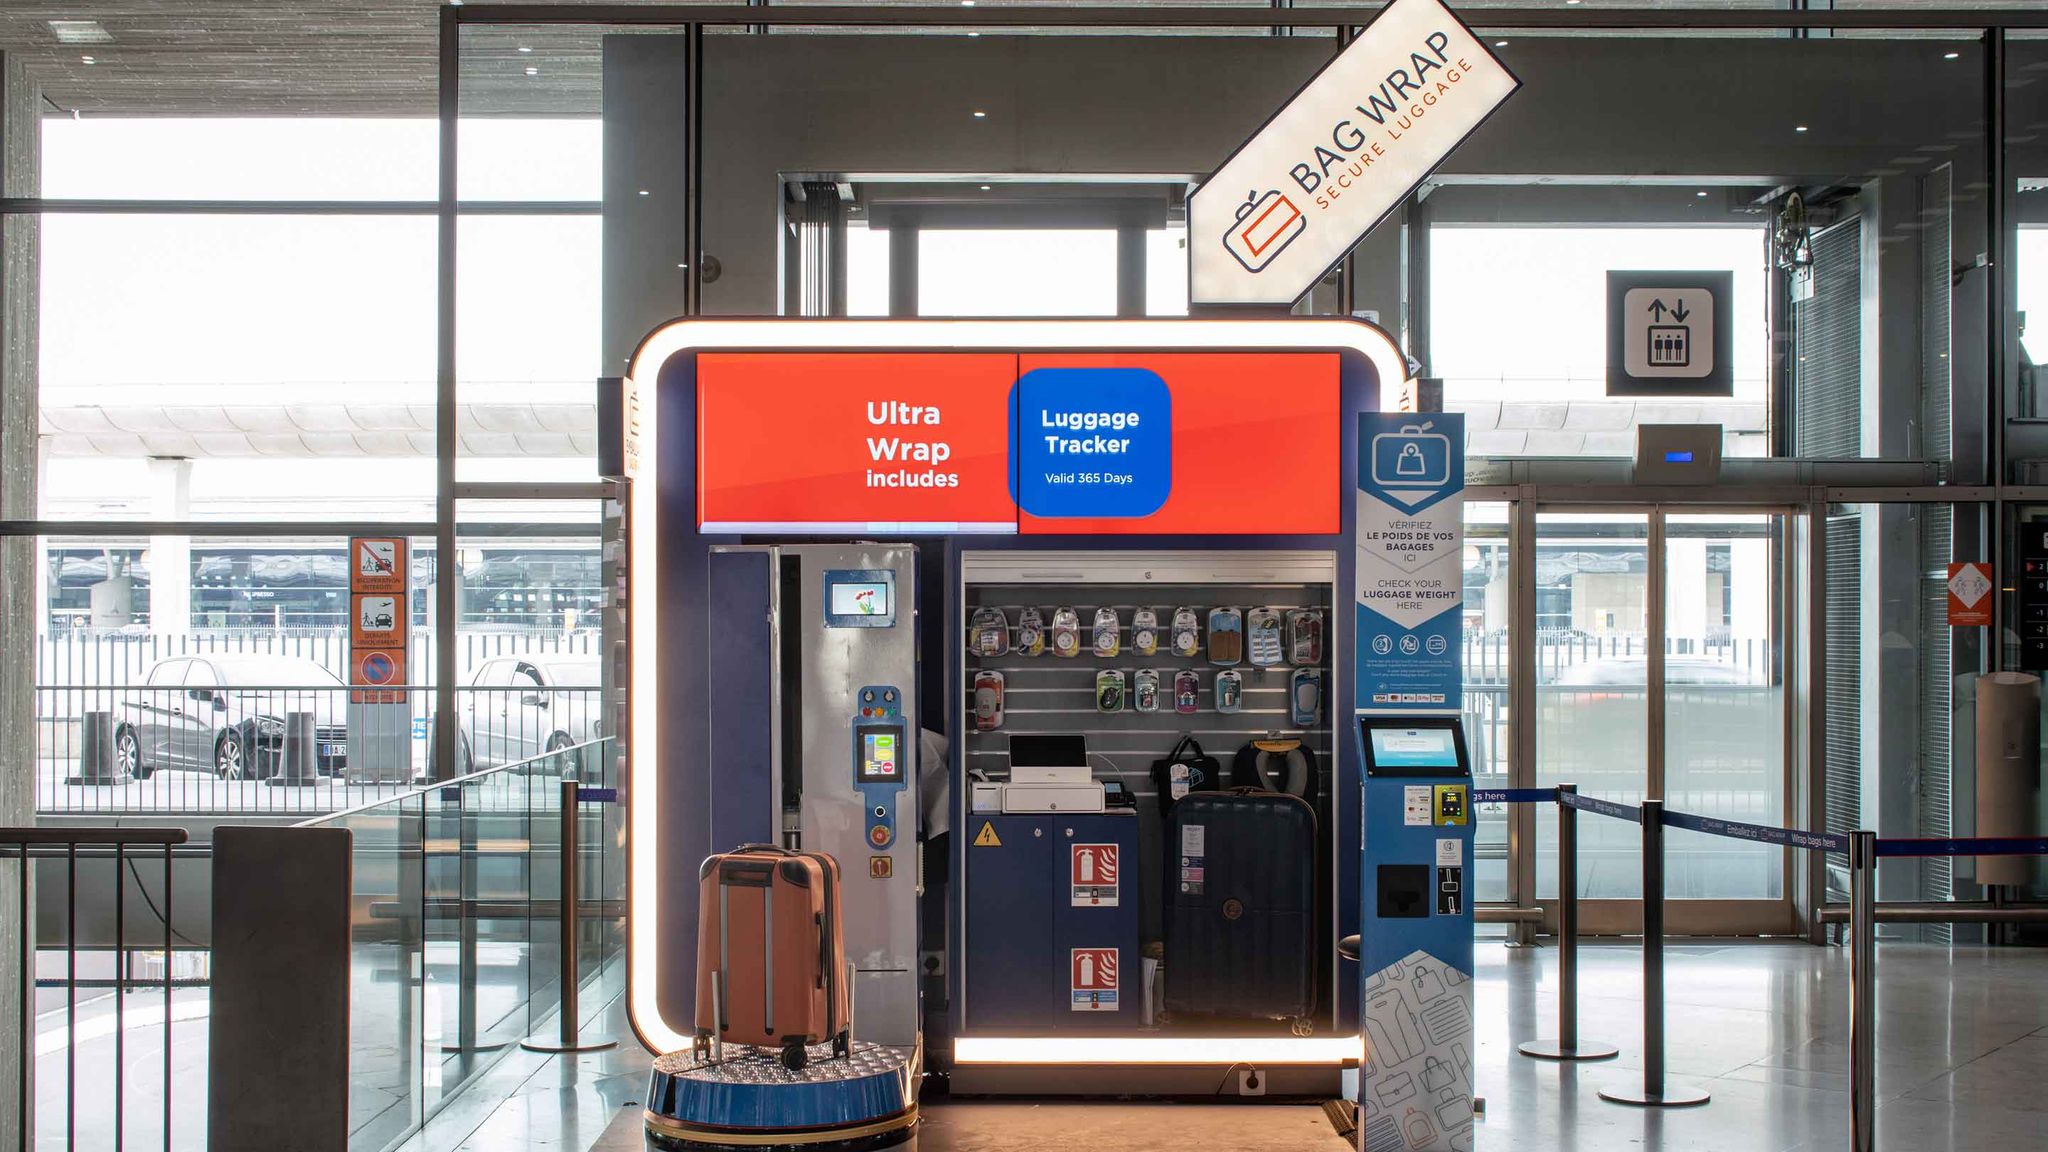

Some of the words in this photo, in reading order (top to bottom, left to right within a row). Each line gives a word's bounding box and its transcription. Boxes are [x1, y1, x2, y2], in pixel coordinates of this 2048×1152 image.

[1288, 120, 1366, 195] BAG
[1355, 30, 1450, 125] WRAP
[1315, 142, 1386, 210] SECURE
[1388, 58, 1472, 140] LUGGAGE
[867, 400, 941, 425] Ultra
[1042, 409, 1140, 431] Luggage
[867, 437, 951, 465] Wrap
[1045, 435, 1130, 454] Tracker
[866, 470, 959, 489] includes
[1045, 472, 1075, 484] Valid
[1078, 472, 1101, 484] 365
[1104, 472, 1134, 485] Days
[1388, 520, 1433, 530] VÉRIFIEZ
[1366, 531, 1379, 540] LE
[1382, 531, 1413, 540] POIDS
[1416, 532, 1430, 540] DE
[1433, 532, 1454, 541] VOS
[1386, 543, 1435, 552] BAGAGES
[1403, 554, 1417, 562] ICI
[1378, 579, 1411, 588] CHECK
[1414, 579, 1442, 588] YOUR
[1363, 591, 1412, 599] LUGGAGE
[1415, 591, 1457, 599] WEIGHT
[1396, 602, 1423, 610] HERE
[1485, 791, 1506, 801] here
[1792, 832, 1807, 845] Wrap
[1808, 835, 1822, 848] bags
[1823, 837, 1836, 848] here
